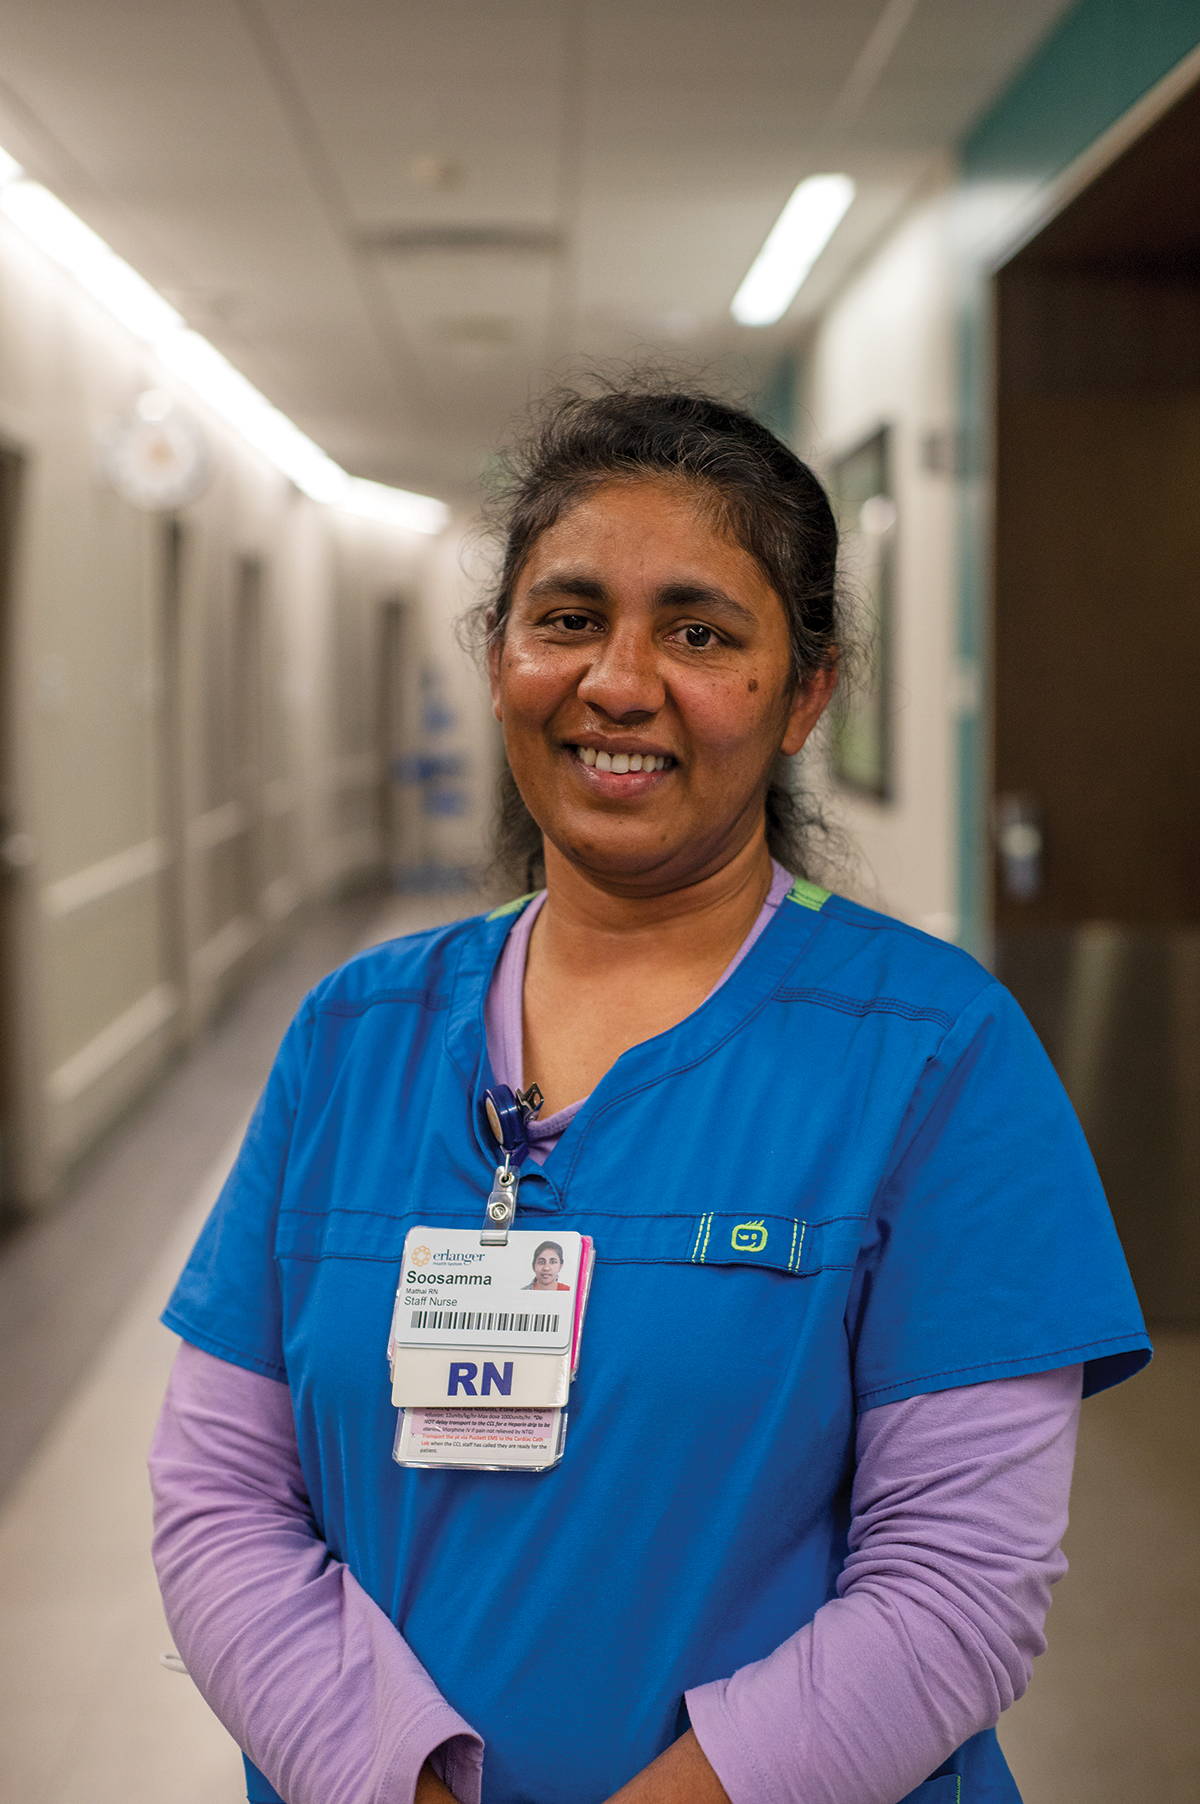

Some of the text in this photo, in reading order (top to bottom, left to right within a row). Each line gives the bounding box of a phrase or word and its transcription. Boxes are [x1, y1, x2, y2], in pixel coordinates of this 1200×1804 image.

[432, 1248, 486, 1266] erlanger
[406, 1270, 492, 1286] Soosamma
[404, 1296, 458, 1306] Staff Nurse
[447, 1361, 514, 1396] RN
